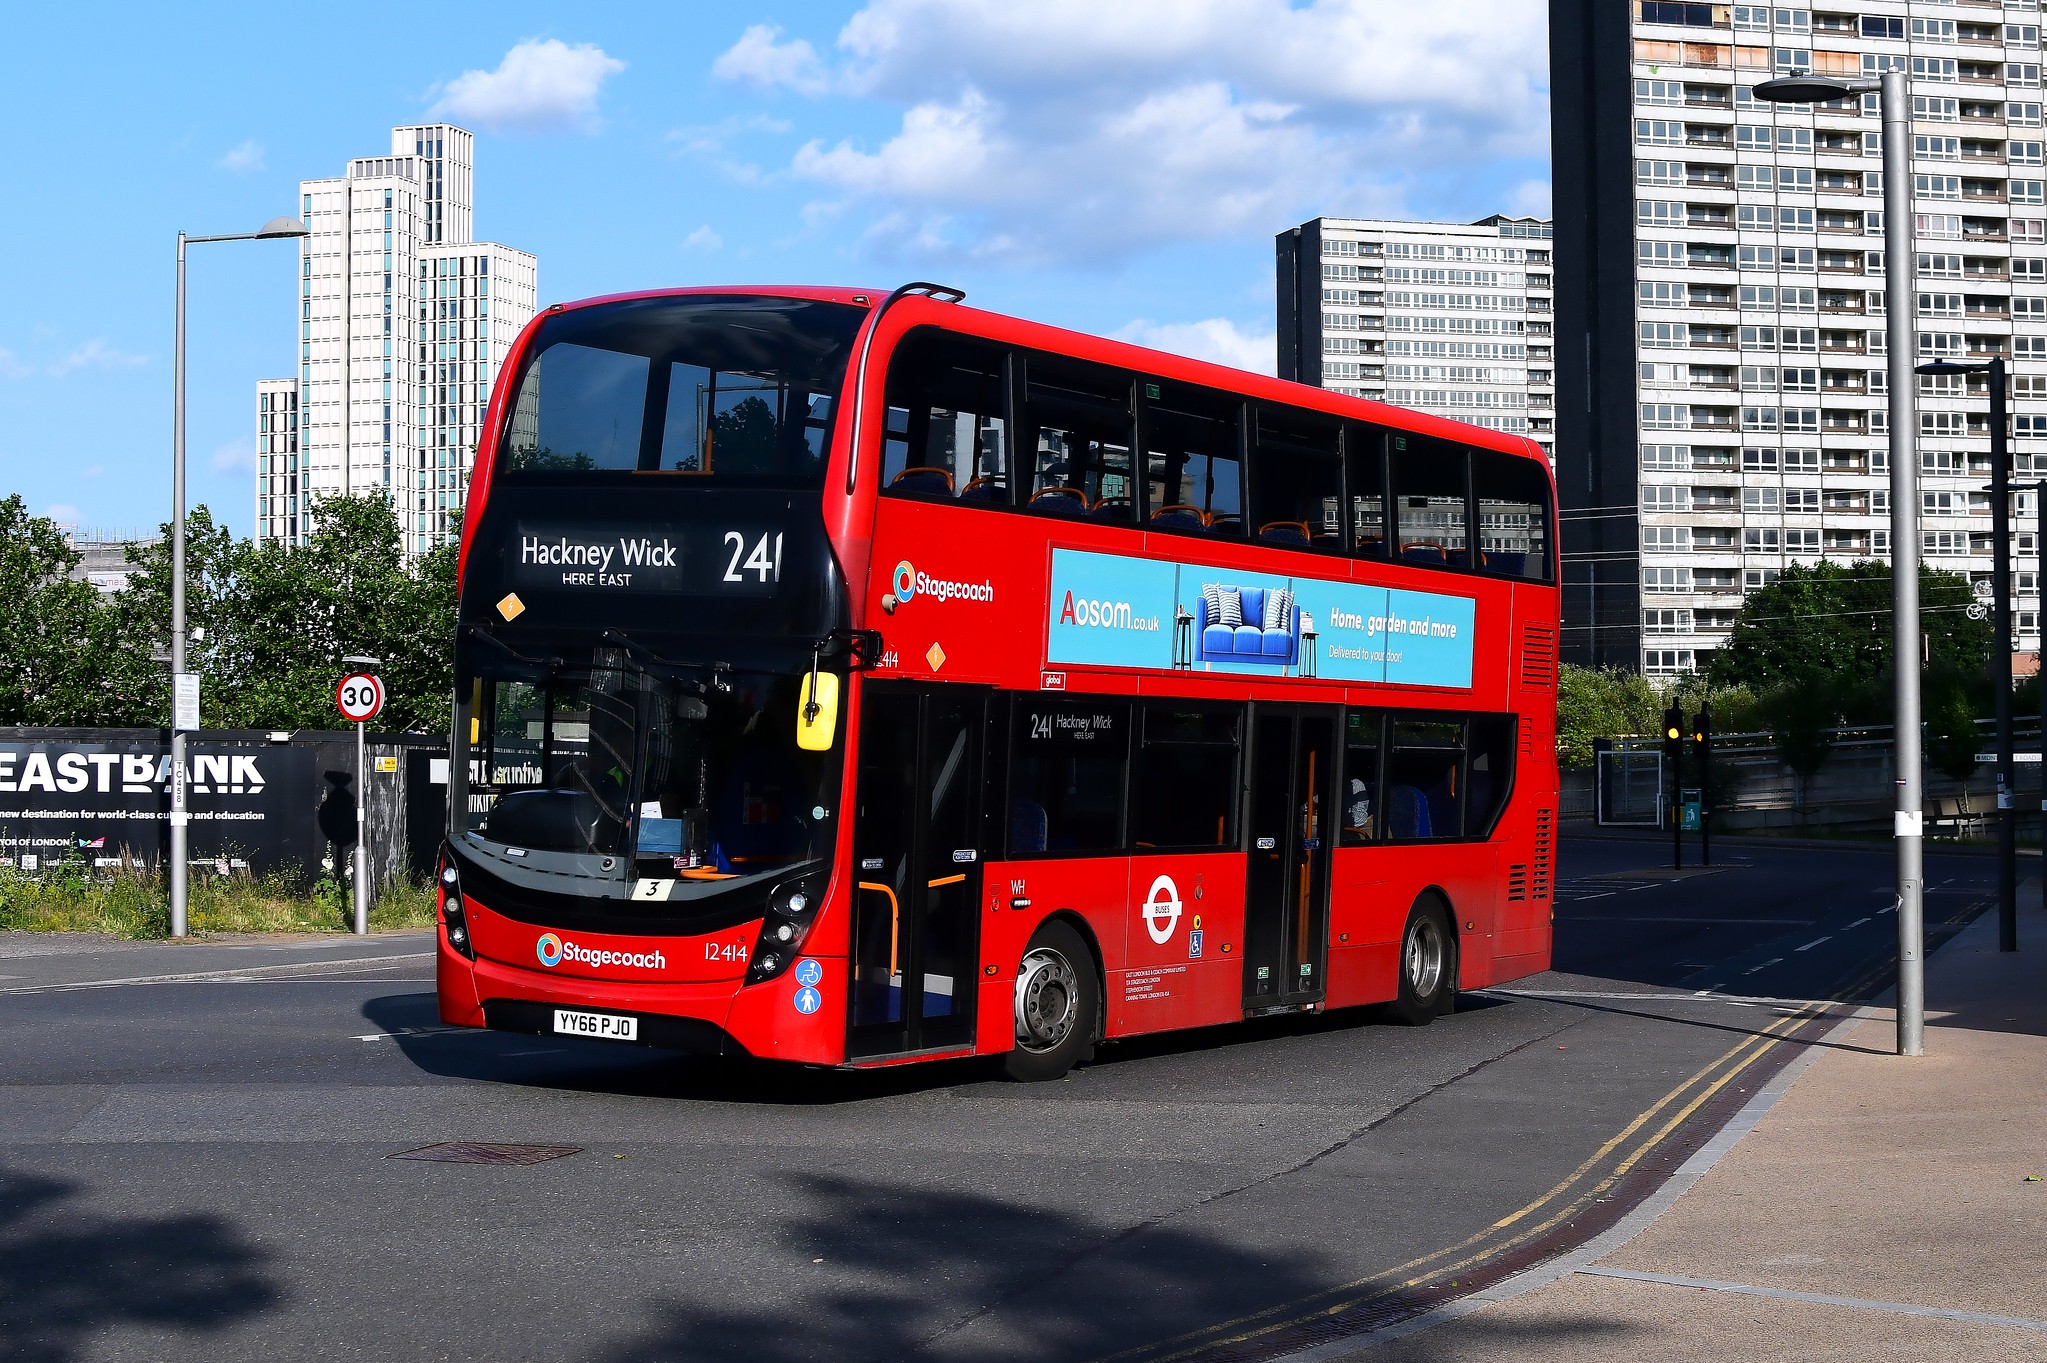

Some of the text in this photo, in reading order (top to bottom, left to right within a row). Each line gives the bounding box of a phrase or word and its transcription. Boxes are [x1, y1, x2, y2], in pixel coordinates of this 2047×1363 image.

[521, 531, 783, 583] Hackney Wick 241
[562, 572, 632, 587] HERE EAST
[916, 571, 993, 602] Stagecoach
[1059, 589, 1160, 632] Aosom.co.uk
[1330, 606, 1457, 639] Home, garden and more
[1328, 644, 1403, 664] Delivered to your door!
[1046, 675, 1061, 688] global
[343, 686, 374, 707] 30
[1031, 713, 1113, 739] 241 Hackney Wick
[1074, 732, 1095, 740] HERE EAST
[21, 809, 79, 819] destination
[80, 810, 96, 819] for
[97, 810, 155, 819] world-class
[194, 811, 214, 820] and
[215, 811, 265, 820] education
[645, 881, 660, 896] 3
[1011, 879, 1025, 895] WH
[1155, 905, 1170, 914] BUSES
[562, 941, 748, 969] Stagecoach 12414
[560, 1013, 630, 1036] YY66 PJO
